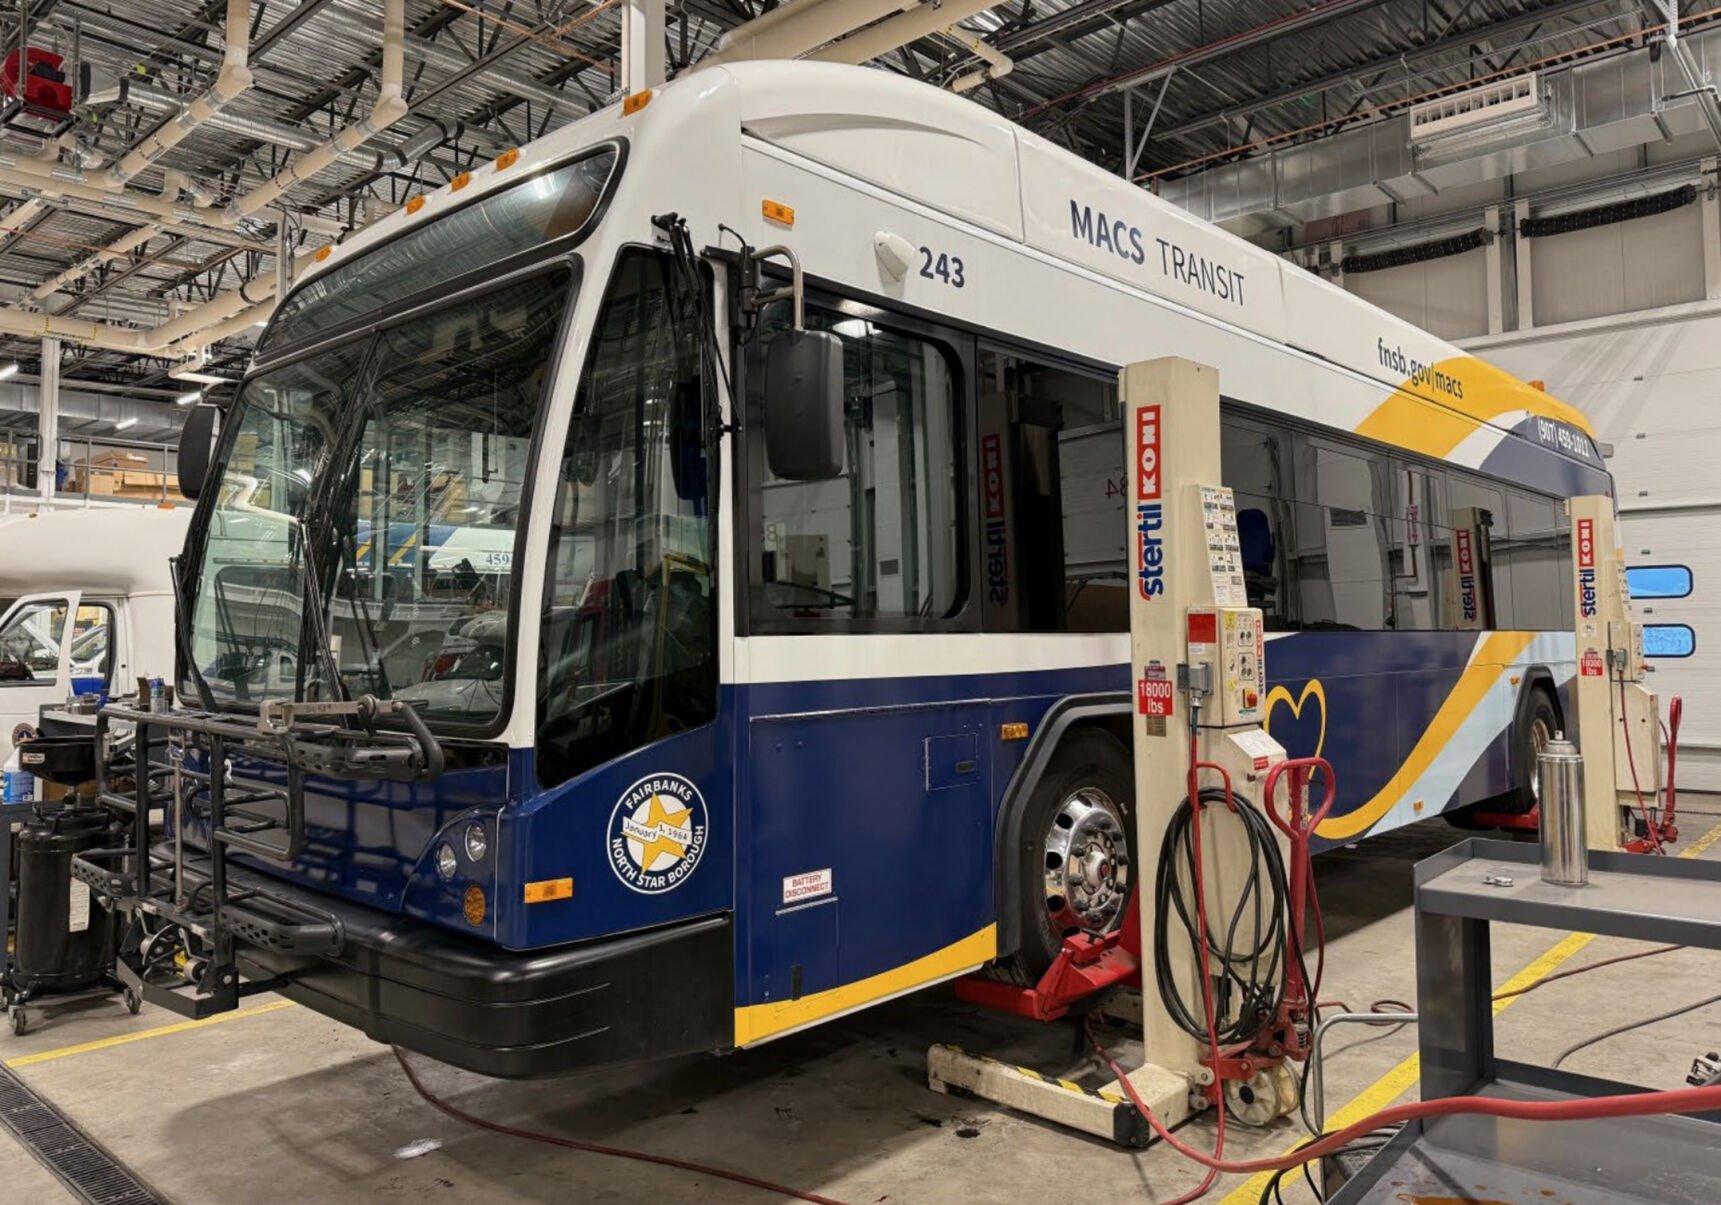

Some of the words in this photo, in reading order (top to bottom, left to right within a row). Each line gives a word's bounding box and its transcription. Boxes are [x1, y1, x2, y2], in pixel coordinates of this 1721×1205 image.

[919, 246, 965, 288] 243
[1070, 199, 1145, 265] MACS
[1156, 238, 1245, 306] TRANSIT
[1141, 410, 1157, 496] KONI
[1137, 503, 1164, 601] stertil
[1580, 521, 1591, 565] KONI
[1579, 568, 1596, 618] stertil
[1139, 682, 1171, 698] 18000
[1147, 698, 1164, 713] lbs
[625, 780, 692, 809] FAIRBANKS
[625, 821, 658, 840] January
[668, 827, 688, 840] 1964
[612, 838, 638, 881] NORTH
[636, 874, 666, 888] STAR
[667, 825, 704, 883] BOROUGH
[785, 881, 829, 898] DISCONNECT
[792, 875, 822, 887] BATTERY
